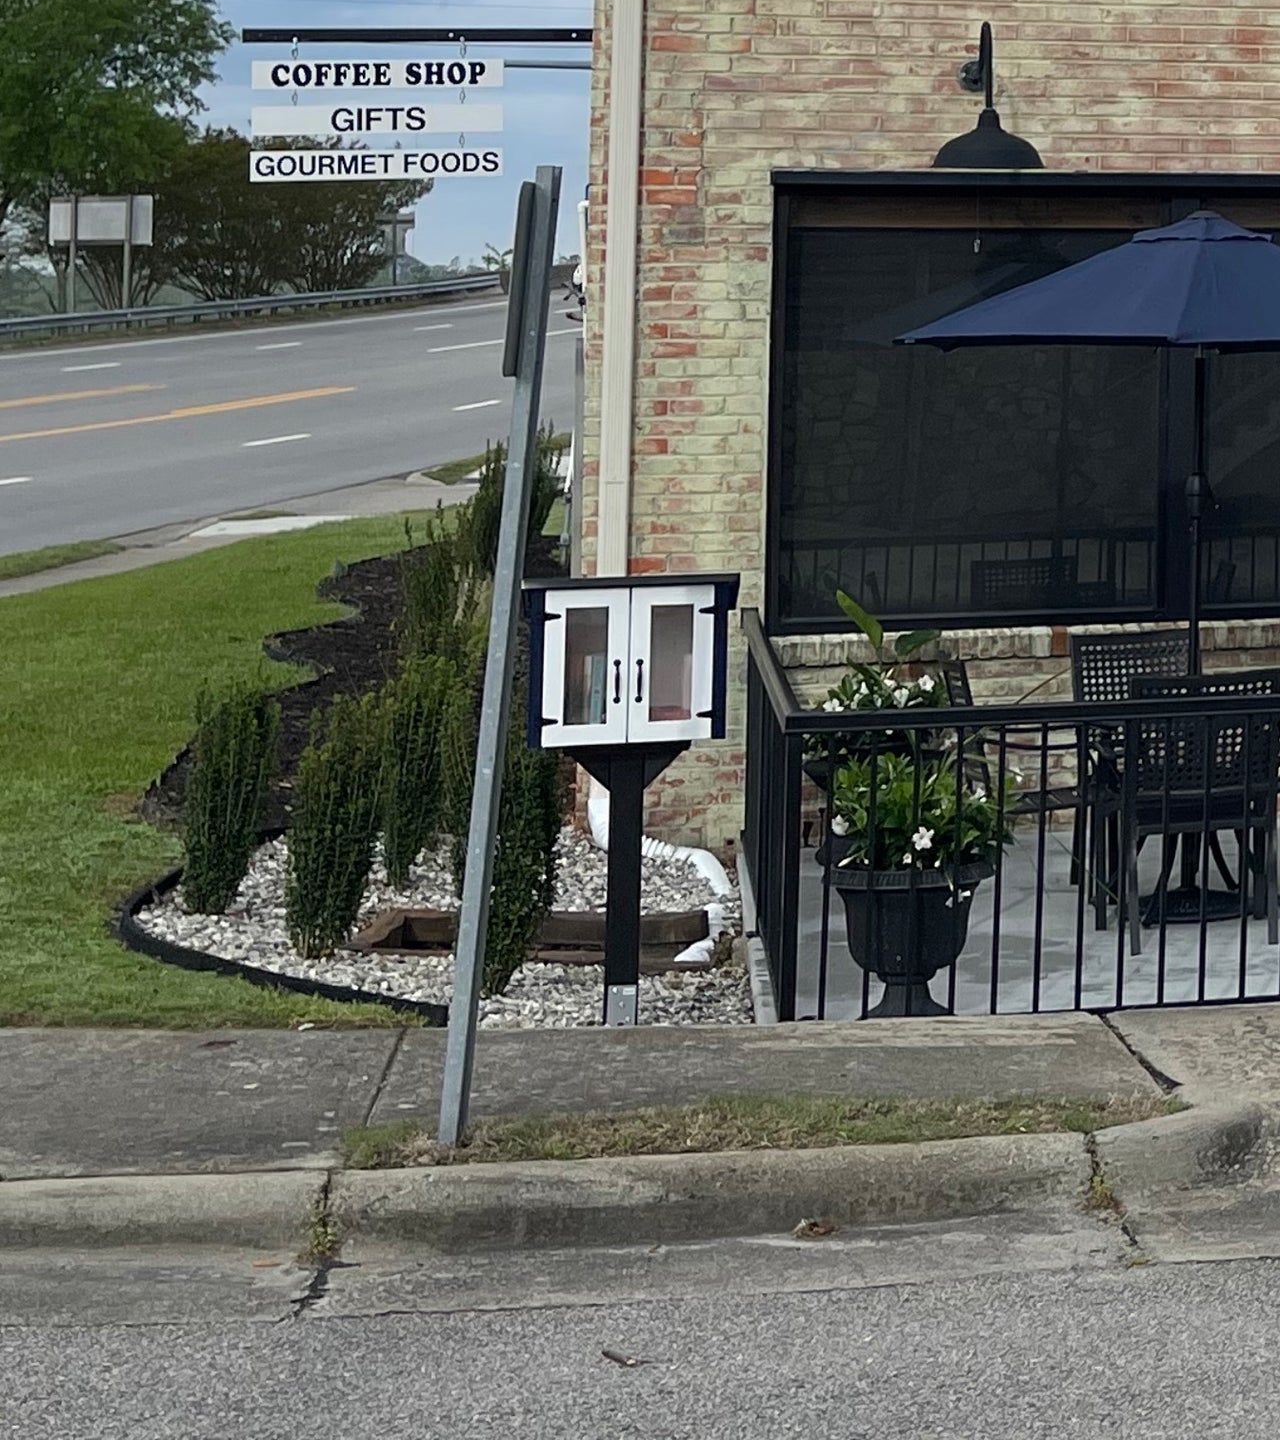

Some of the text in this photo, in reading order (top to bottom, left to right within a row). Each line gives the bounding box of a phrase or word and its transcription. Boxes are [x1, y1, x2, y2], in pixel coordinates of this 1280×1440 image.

[271, 61, 487, 87] COFFEE SHOP
[331, 106, 426, 132] GIFTS
[255, 151, 500, 177] GOURMET FOODS
